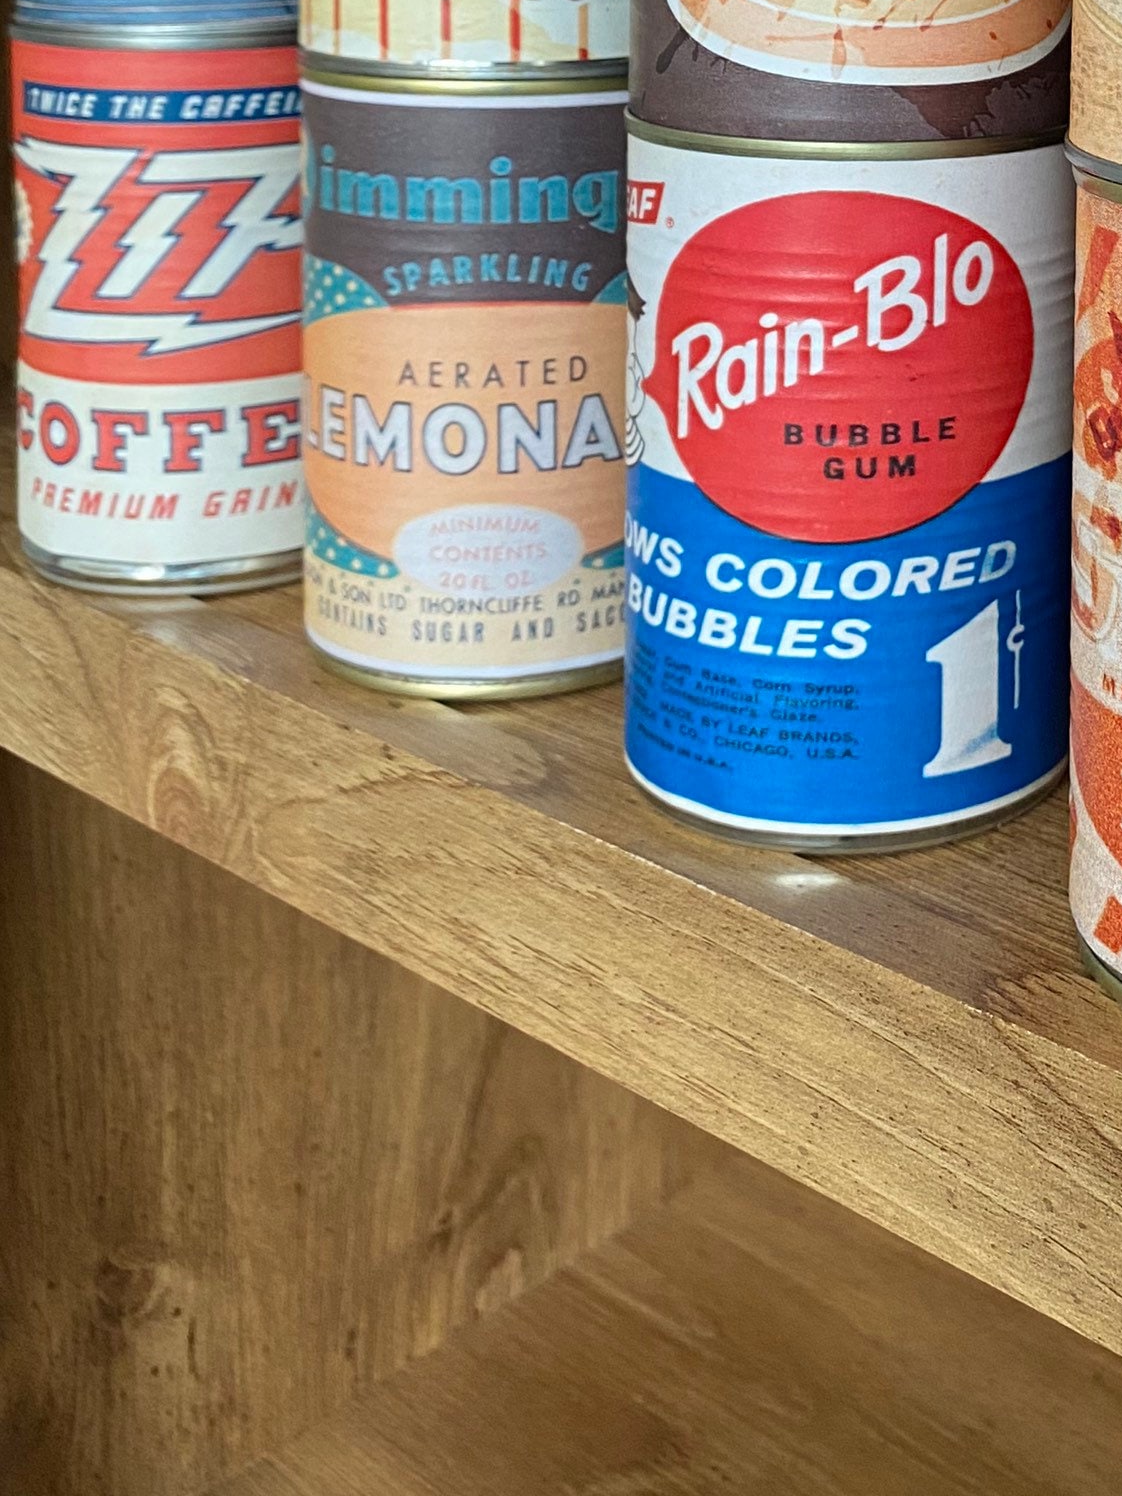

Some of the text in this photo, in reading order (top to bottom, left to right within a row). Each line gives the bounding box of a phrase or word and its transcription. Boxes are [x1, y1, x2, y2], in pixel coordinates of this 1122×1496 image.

[28, 87, 303, 120] TWICE THE CAFFEI
[319, 144, 620, 235] imming
[627, 186, 657, 220] AF
[382, 253, 594, 298] SPARKLING
[671, 233, 995, 441] Rain-Blo
[399, 354, 590, 389] AERATED
[784, 416, 957, 447] BUBBLE
[823, 455, 918, 481] GUM
[31, 476, 179, 520] PREMIUM
[428, 516, 540, 537] MINIMUM
[428, 542, 548, 563] CONTENTS
[705, 540, 1017, 601] COLORED
[411, 618, 485, 643] SUGAR
[511, 616, 555, 643] AND
[628, 572, 872, 659] BUBBLES
[752, 678, 793, 694] Corn
